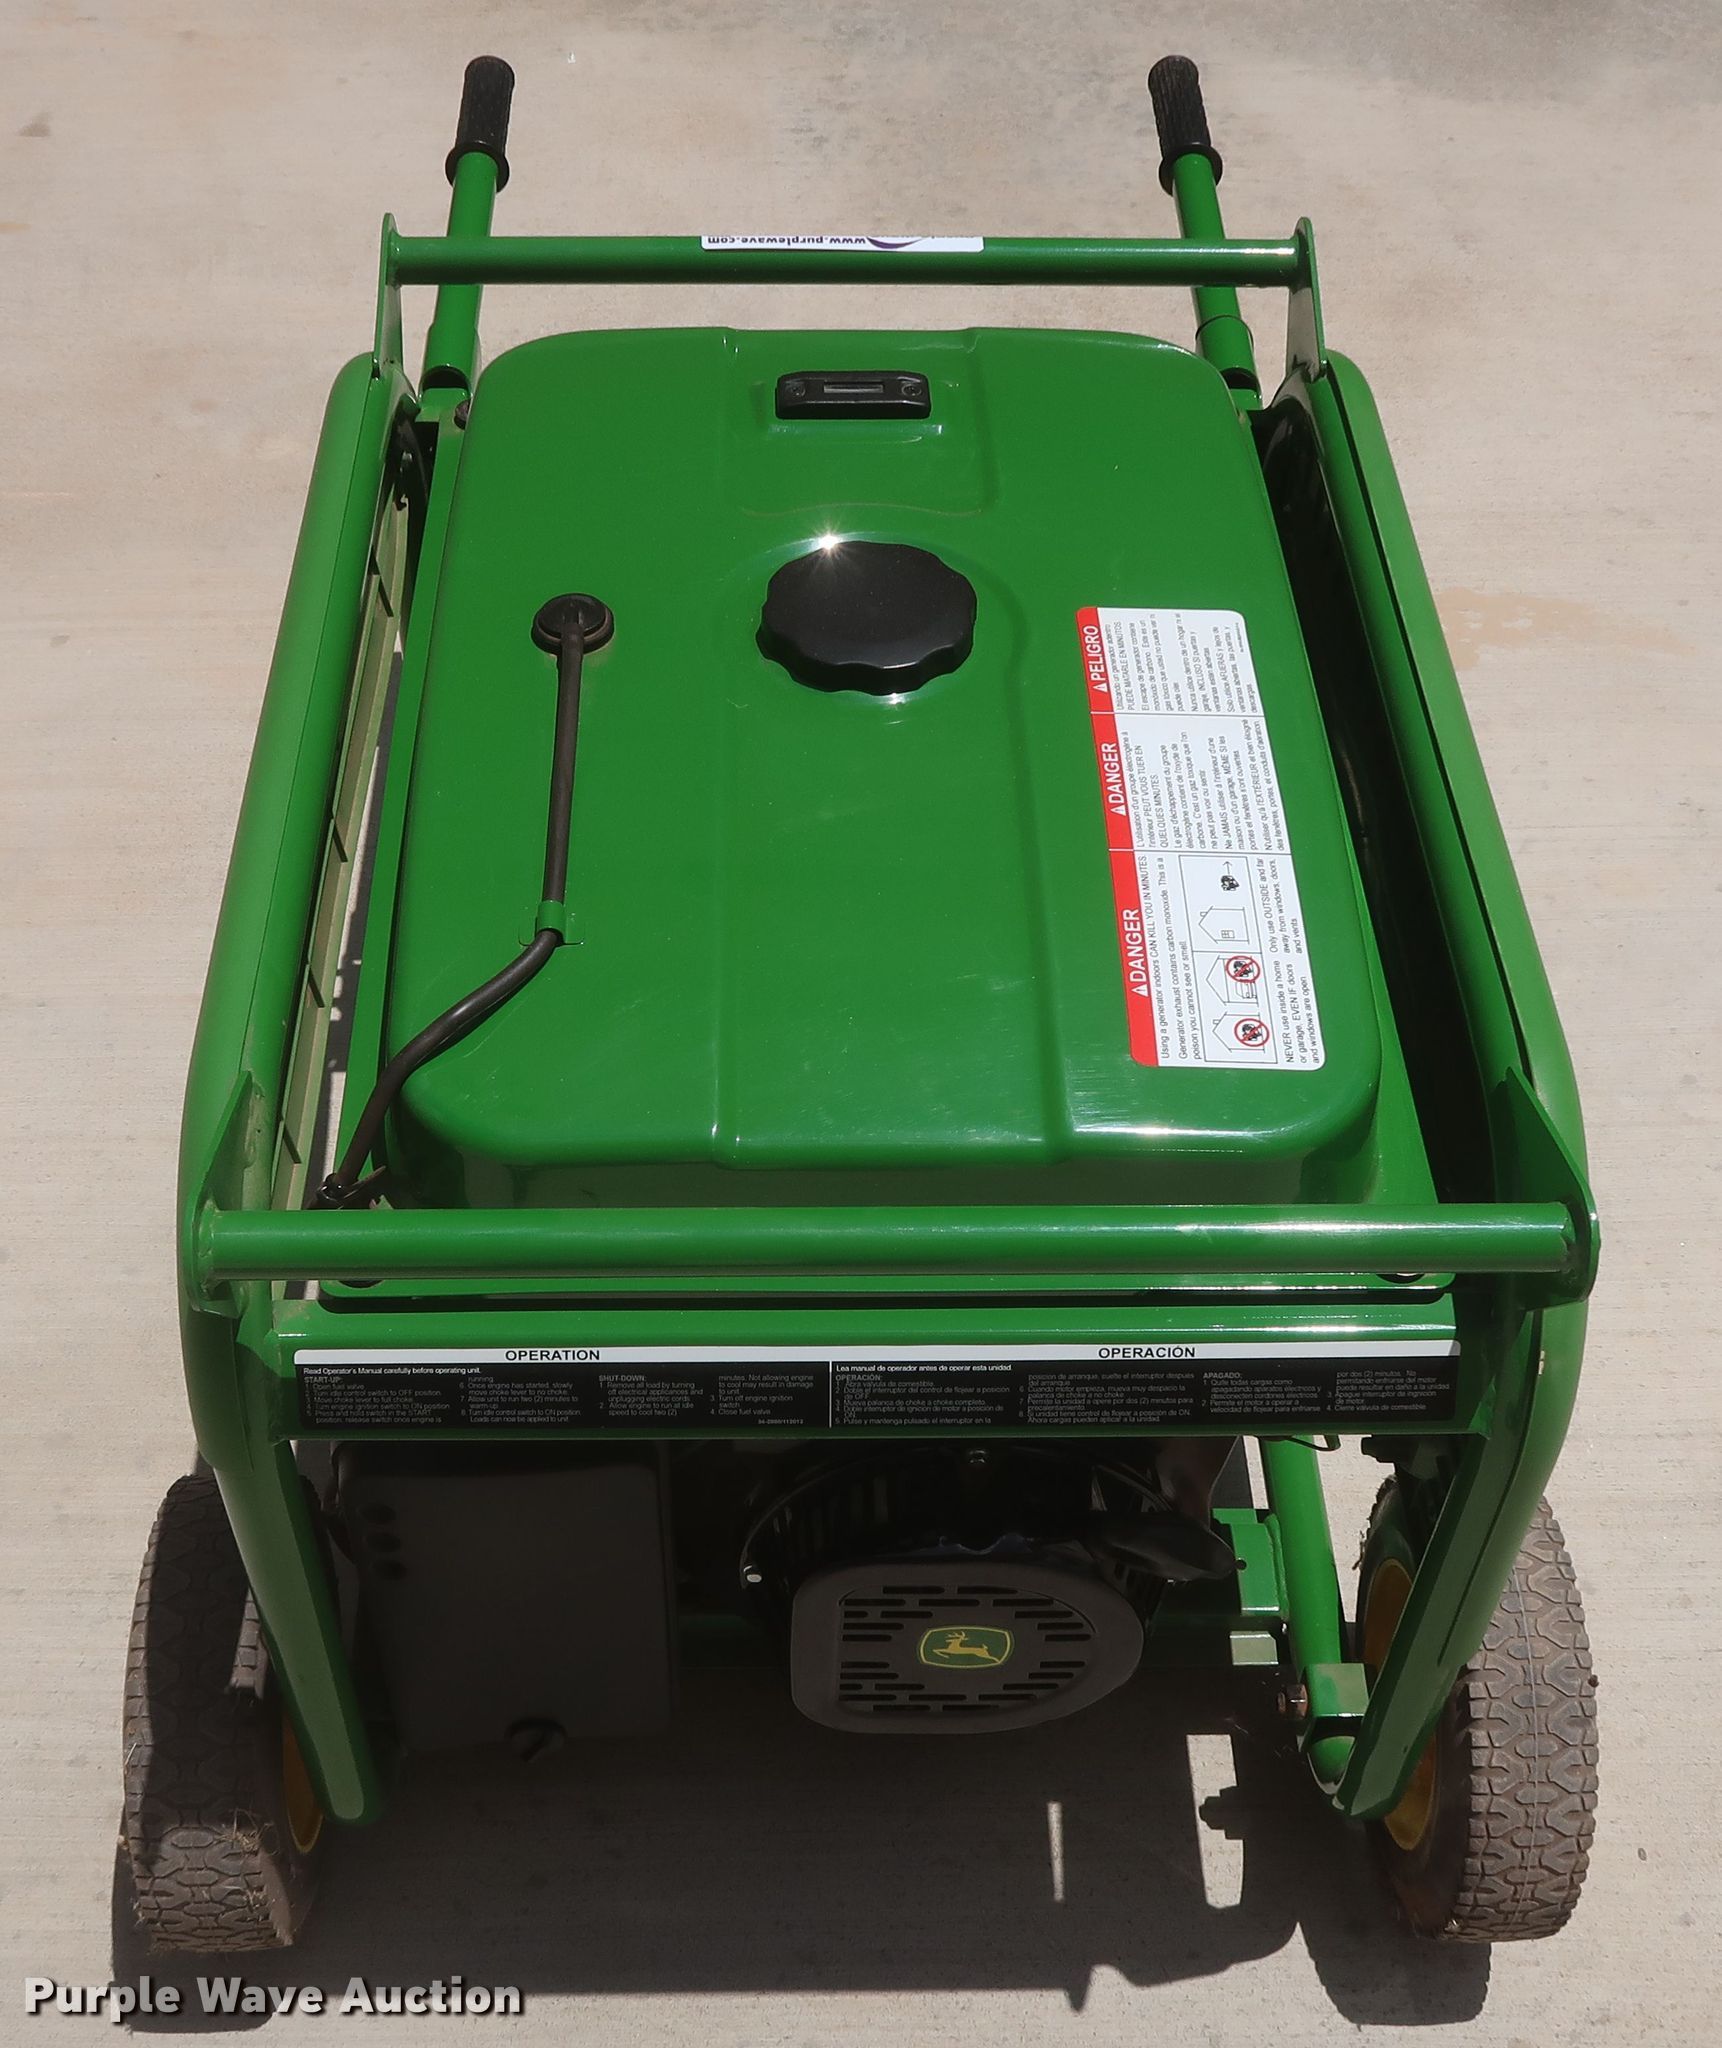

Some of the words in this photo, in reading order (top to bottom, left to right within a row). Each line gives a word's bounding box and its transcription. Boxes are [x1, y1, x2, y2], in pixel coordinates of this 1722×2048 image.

[708, 236, 866, 245] www.purplewave.com
[1082, 625, 1107, 680] PELIGRO
[1100, 742, 1124, 803] DANGER
[1255, 857, 1264, 867] far
[1156, 871, 1166, 885] This
[1257, 868, 1267, 881] and
[1142, 892, 1151, 900] IN
[1259, 883, 1273, 918] OUTSIDE
[1143, 902, 1154, 919] YOU
[1146, 921, 1156, 937] KILL
[1267, 920, 1275, 933] use
[1276, 915, 1287, 931] from
[1121, 909, 1147, 981] DANGER
[1164, 926, 1175, 951] carbon
[1267, 935, 1279, 952] Only
[1281, 933, 1292, 953] away
[1292, 939, 1302, 953] and
[1148, 939, 1158, 957] CAN
[1151, 959, 1162, 987] indoors
[1168, 953, 1179, 985] contains
[1182, 962, 1190, 970] or
[1271, 960, 1282, 981] home
[1284, 963, 1295, 985] doors
[1183, 972, 1192, 986] see
[1154, 989, 1168, 1026] generator
[1171, 986, 1183, 1017] exhaust
[1185, 988, 1196, 1014] cannot
[1275, 990, 1287, 1013] inside
[1288, 996, 1301, 1020] EVEN
[1303, 997, 1311, 1010] are
[1189, 1016, 1199, 1031] you
[1281, 1015, 1290, 1030] use
[1304, 1012, 1317, 1046] windows
[1158, 1035, 1172, 1058] Using
[1174, 1019, 1188, 1059] Generator
[1189, 1033, 1204, 1059] poison
[1281, 1032, 1294, 1062] NEVER
[1299, 1054, 1307, 1063] or
[1309, 1048, 1319, 1063] and
[505, 1350, 599, 1361] OPERATION
[1098, 1344, 1195, 1359] OPERACIÓN
